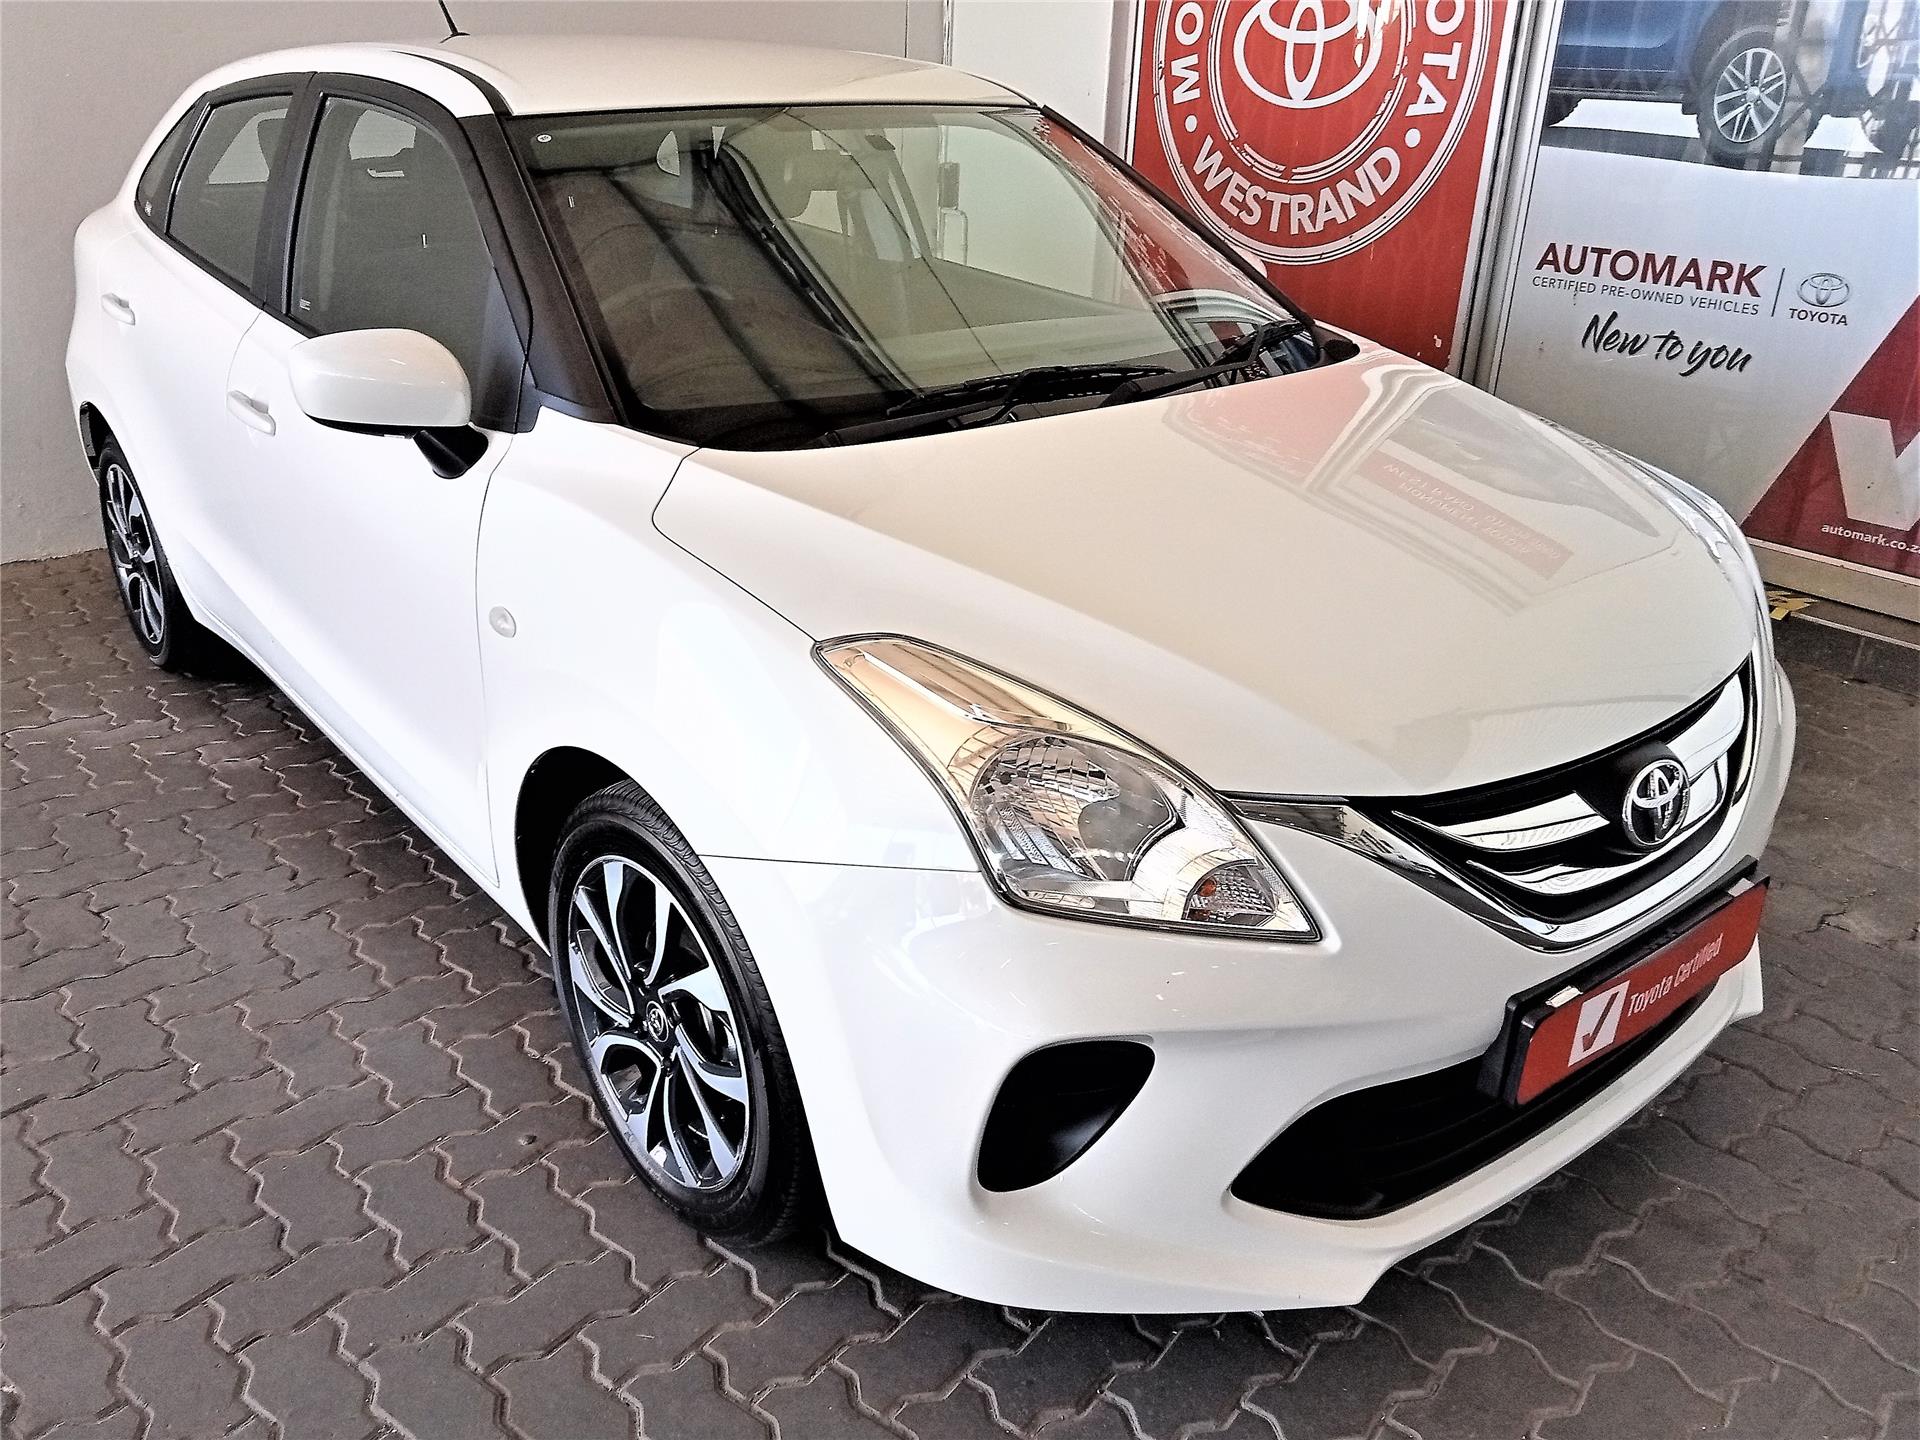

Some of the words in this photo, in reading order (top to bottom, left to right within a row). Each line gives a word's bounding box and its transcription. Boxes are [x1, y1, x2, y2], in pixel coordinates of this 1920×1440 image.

[1192, 134, 1401, 235] WESTRAND
[1532, 276, 1596, 294] CERTIFIED
[1601, 285, 1684, 306] PRE-OWNED
[1689, 296, 1760, 316] VEHICLES
[1535, 242, 1767, 298] AUTOMARK
[1581, 311, 1650, 357] New
[1653, 330, 1684, 361] to
[1679, 340, 1752, 377] you
[1788, 308, 1848, 326] TOYOTA
[1627, 975, 1674, 1017] Toyota
[1673, 932, 1724, 988] Certified
